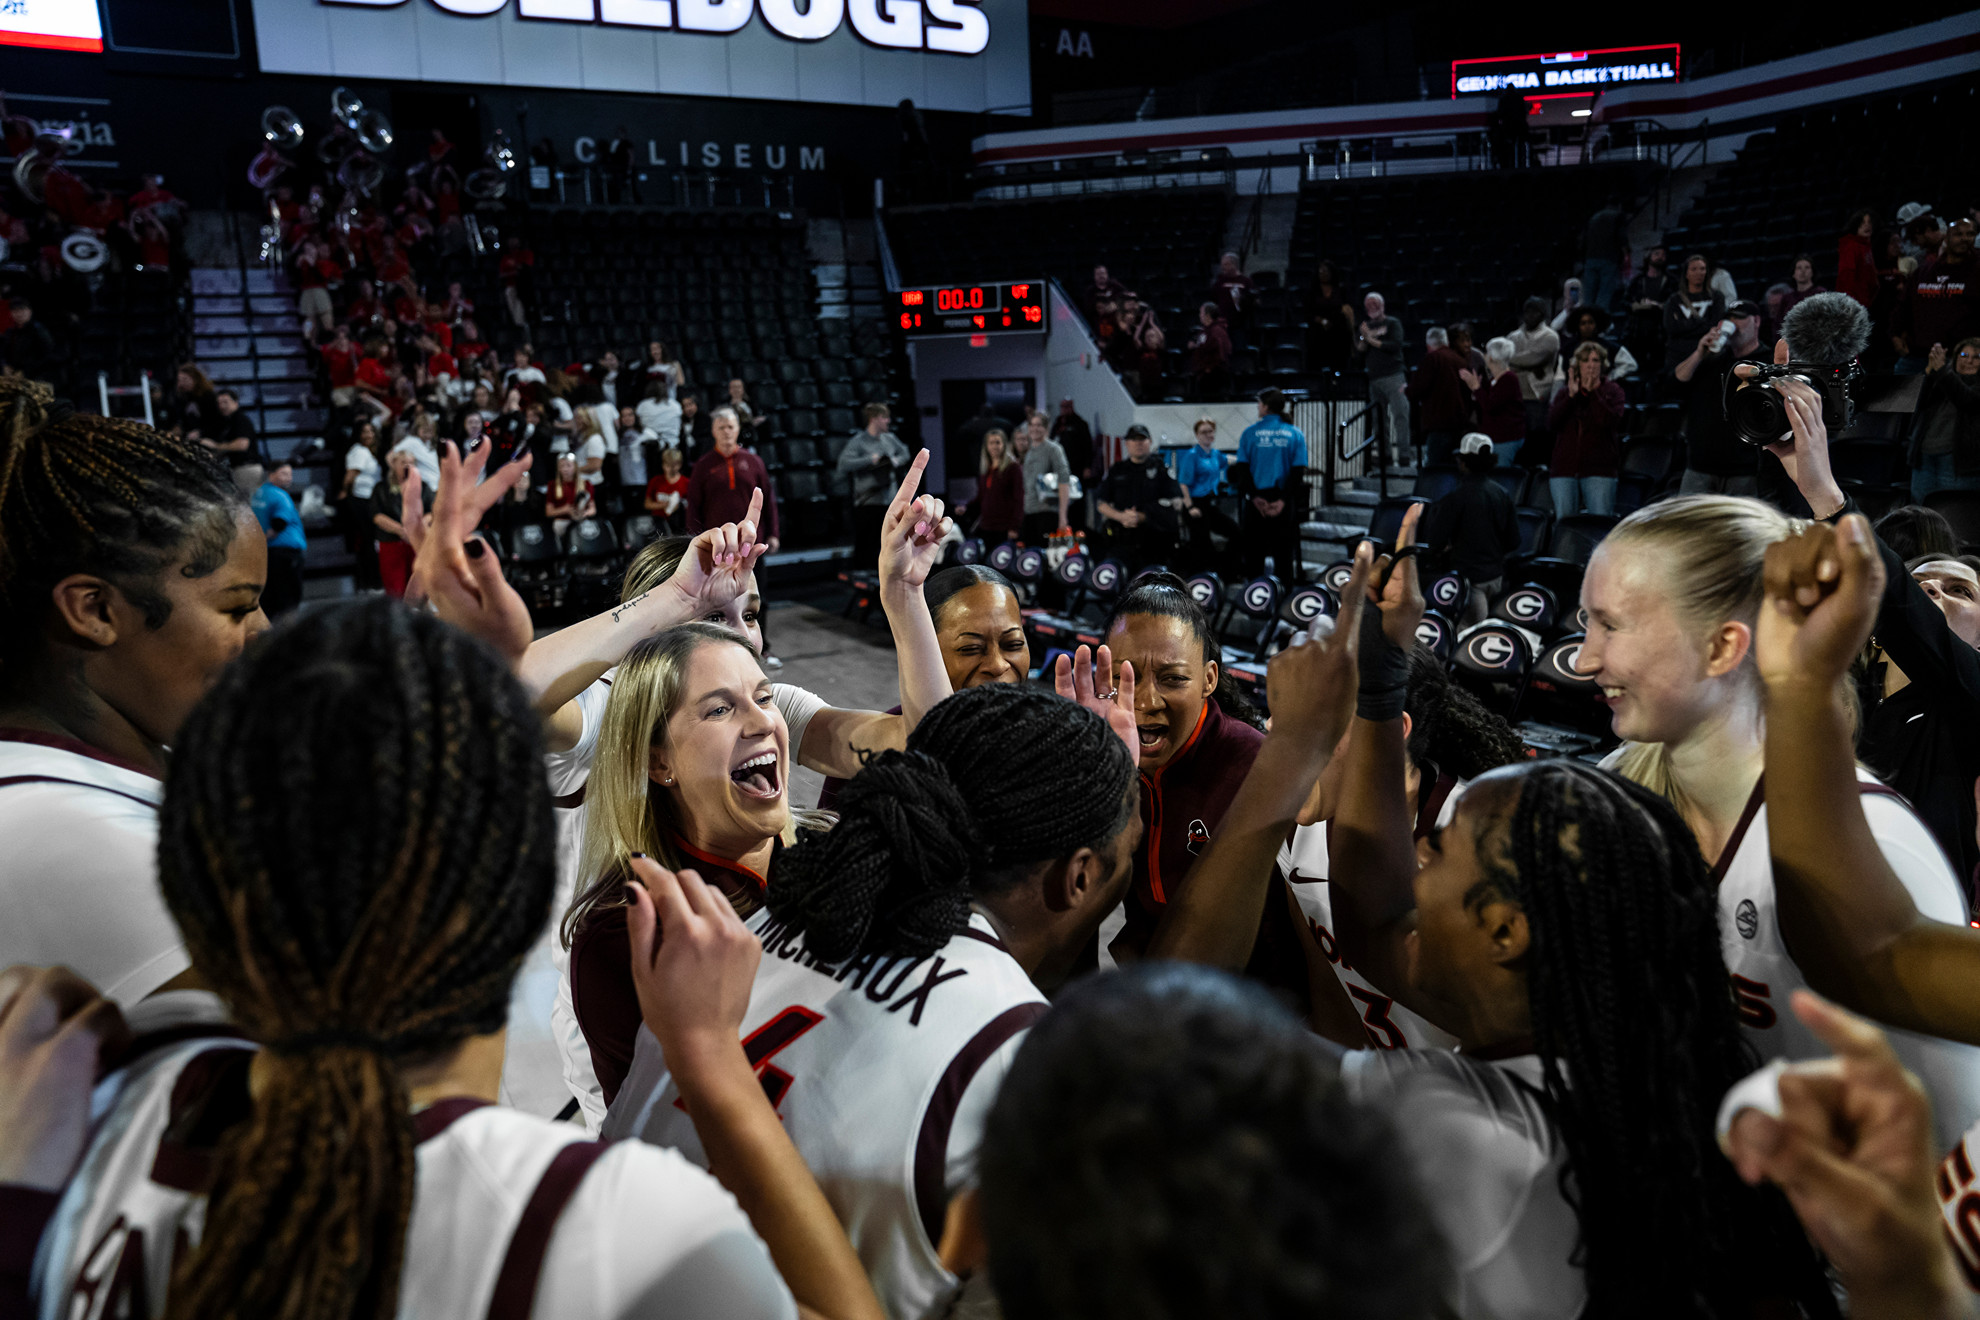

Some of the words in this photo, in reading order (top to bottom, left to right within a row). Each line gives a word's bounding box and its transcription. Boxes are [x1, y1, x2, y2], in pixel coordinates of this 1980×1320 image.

[1055, 27, 1096, 60] AA
[573, 136, 827, 171] CLISEUM
[938, 287, 984, 311] 00.0
